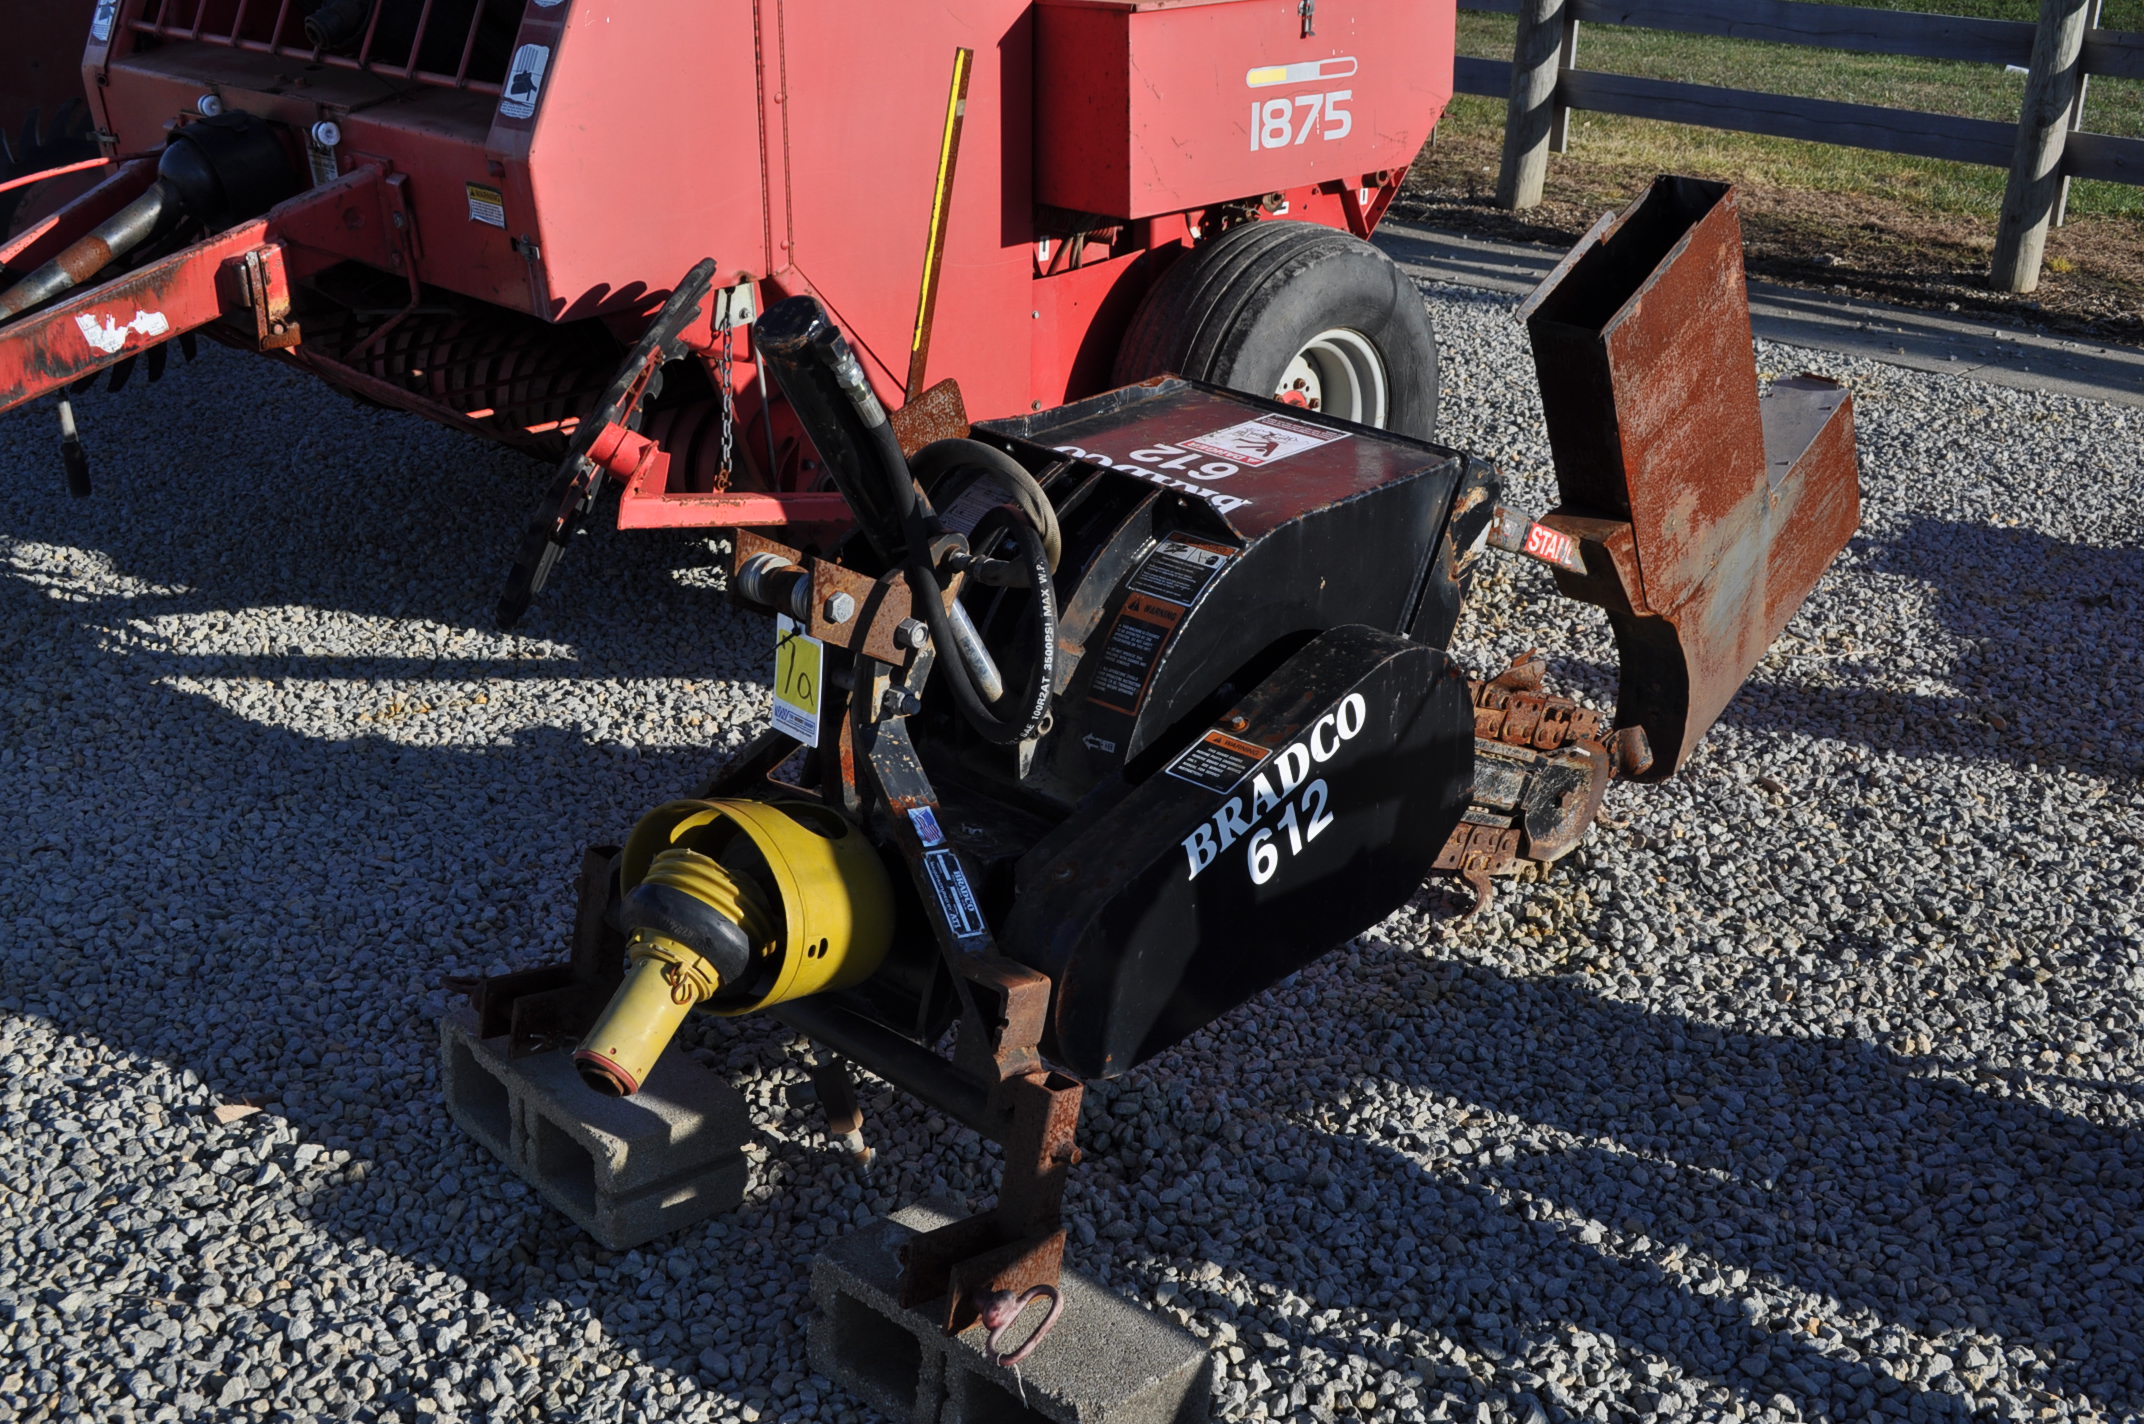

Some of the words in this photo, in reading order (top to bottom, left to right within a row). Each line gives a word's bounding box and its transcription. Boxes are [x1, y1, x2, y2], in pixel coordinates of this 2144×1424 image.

[1250, 89, 1353, 152] 1875
[1129, 443, 1239, 481] 612
[1041, 588, 1053, 617] MAX
[1043, 622, 1054, 671] 3500PSI
[1031, 675, 1051, 720] 100R2AT
[1181, 692, 1367, 881] BRADCO
[1247, 778, 1334, 885] 612
[953, 870, 975, 912] BRADCO
